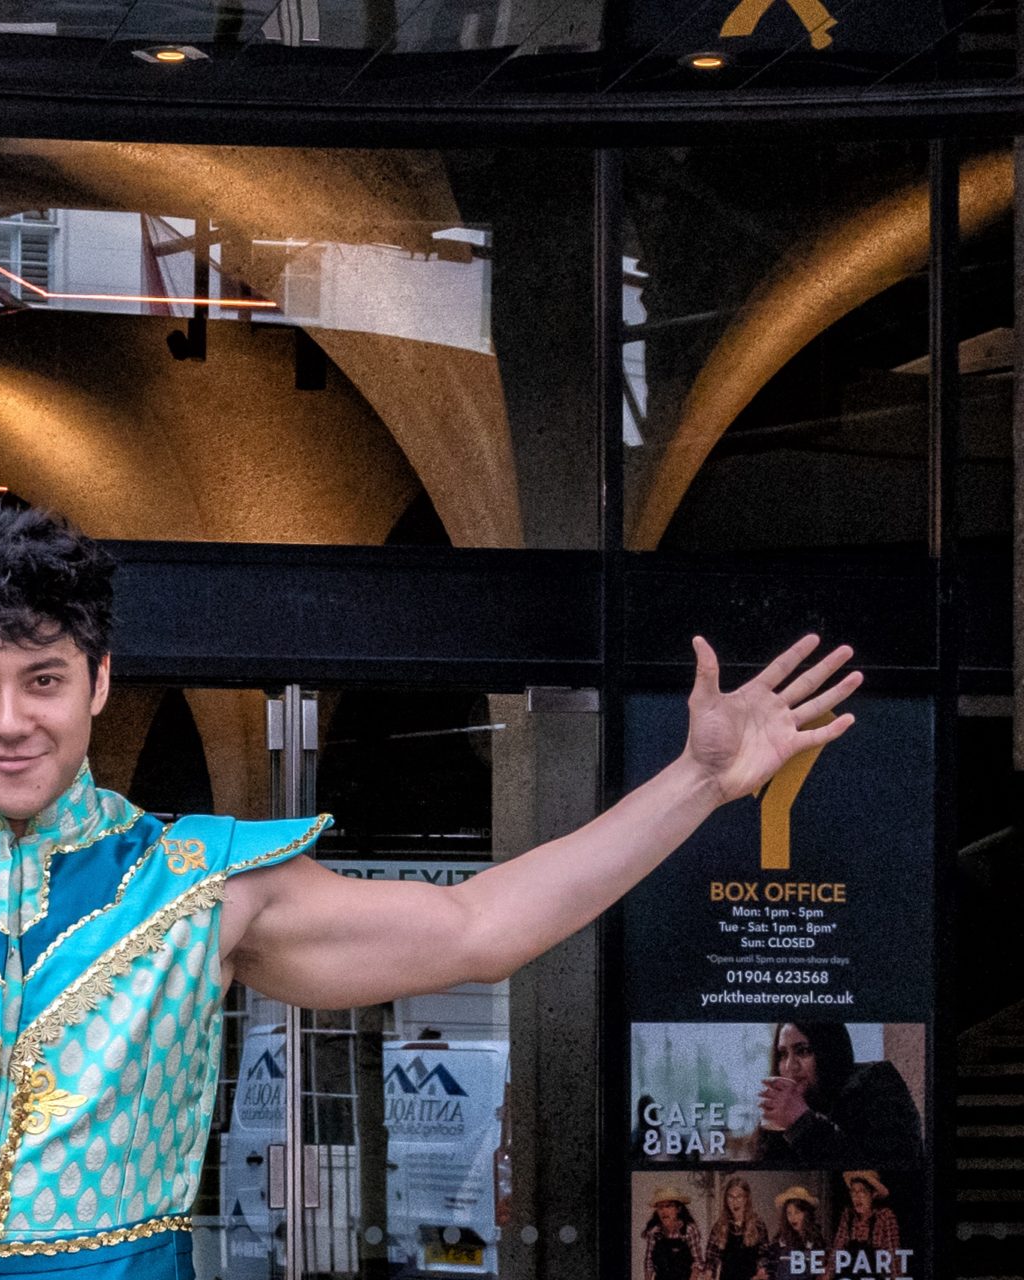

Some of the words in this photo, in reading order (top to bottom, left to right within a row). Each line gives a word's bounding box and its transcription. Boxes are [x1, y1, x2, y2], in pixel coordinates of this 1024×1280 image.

[709, 881, 759, 902] BOX
[764, 881, 847, 903] OFFICE
[732, 906, 761, 918] Mon:
[764, 906, 789, 920] 1pm
[798, 906, 824, 920] 5pm
[718, 921, 739, 933] Tue
[747, 921, 769, 933] Sat:
[772, 922, 797, 935] 1pm
[740, 937, 765, 948] Sun:
[768, 937, 815, 948] CLOSED
[735, 954, 754, 964] until
[756, 955, 775, 965] 5pm
[776, 956, 787, 964] on
[788, 955, 828, 964] non-show
[830, 955, 850, 966] days
[726, 970, 772, 984] 01904
[775, 970, 829, 984] 623568
[701, 989, 854, 1007] yorktheatreroyal.co.uk
[643, 1102, 726, 1127] CAFE
[642, 1130, 726, 1155] &BAR
[789, 1250, 826, 1275] BE
[835, 1249, 914, 1274] PART
